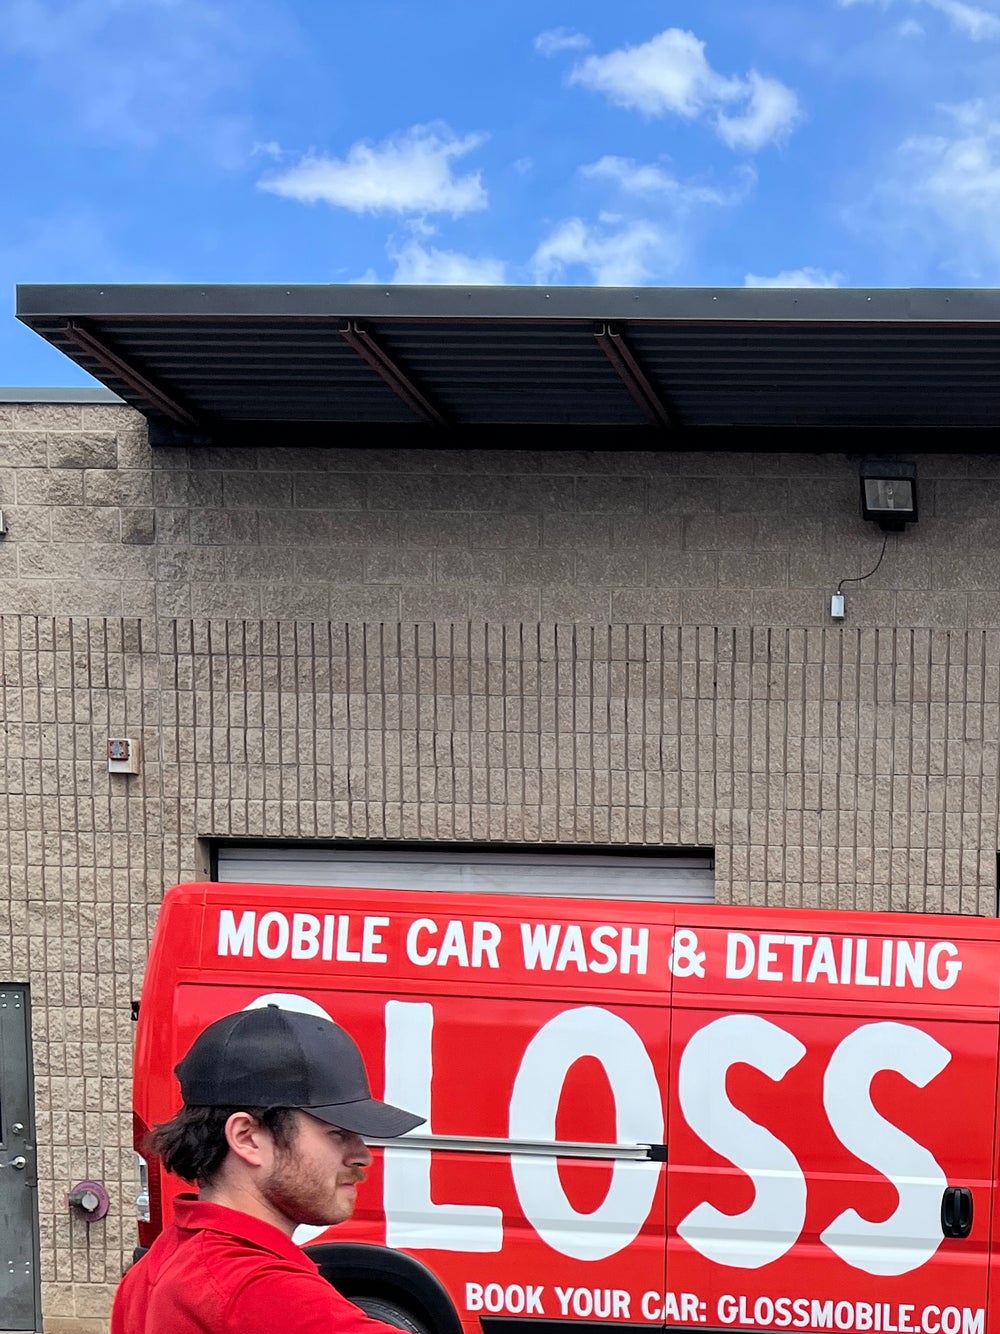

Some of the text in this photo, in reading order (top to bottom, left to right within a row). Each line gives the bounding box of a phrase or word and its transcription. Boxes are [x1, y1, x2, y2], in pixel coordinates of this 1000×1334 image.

[218, 910, 963, 989] MOBILE CAR WASH & DETAILING
[238, 993, 952, 1277] LOSS
[465, 1282, 545, 1315] BOOK
[554, 1286, 631, 1319] YOUR
[641, 1290, 707, 1322] CAR:
